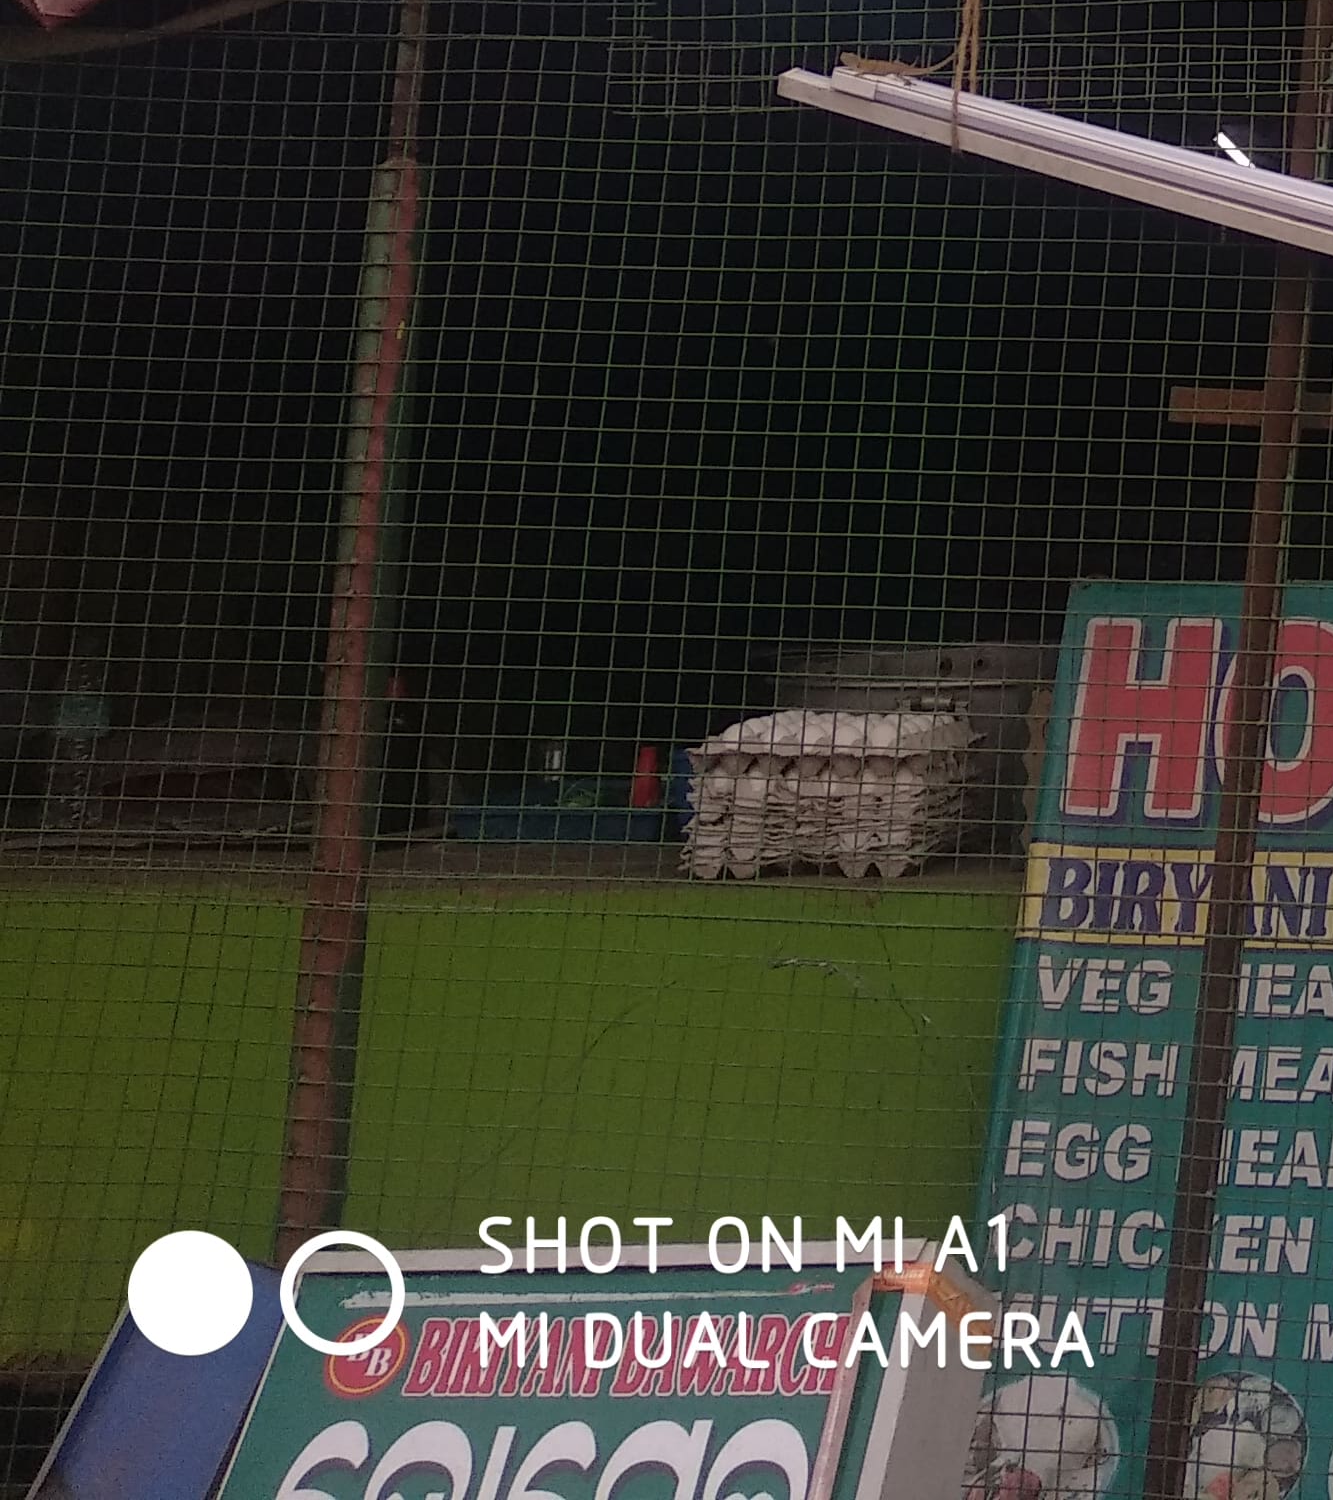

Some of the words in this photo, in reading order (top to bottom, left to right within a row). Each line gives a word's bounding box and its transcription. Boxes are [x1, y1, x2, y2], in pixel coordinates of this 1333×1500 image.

[1040, 856, 1332, 937] BIRYNI
[1037, 954, 1174, 1015] VEG
[1017, 1038, 1180, 1098] FISH
[1004, 1119, 1153, 1182] EGG
[991, 1202, 1315, 1276] CHICEN
